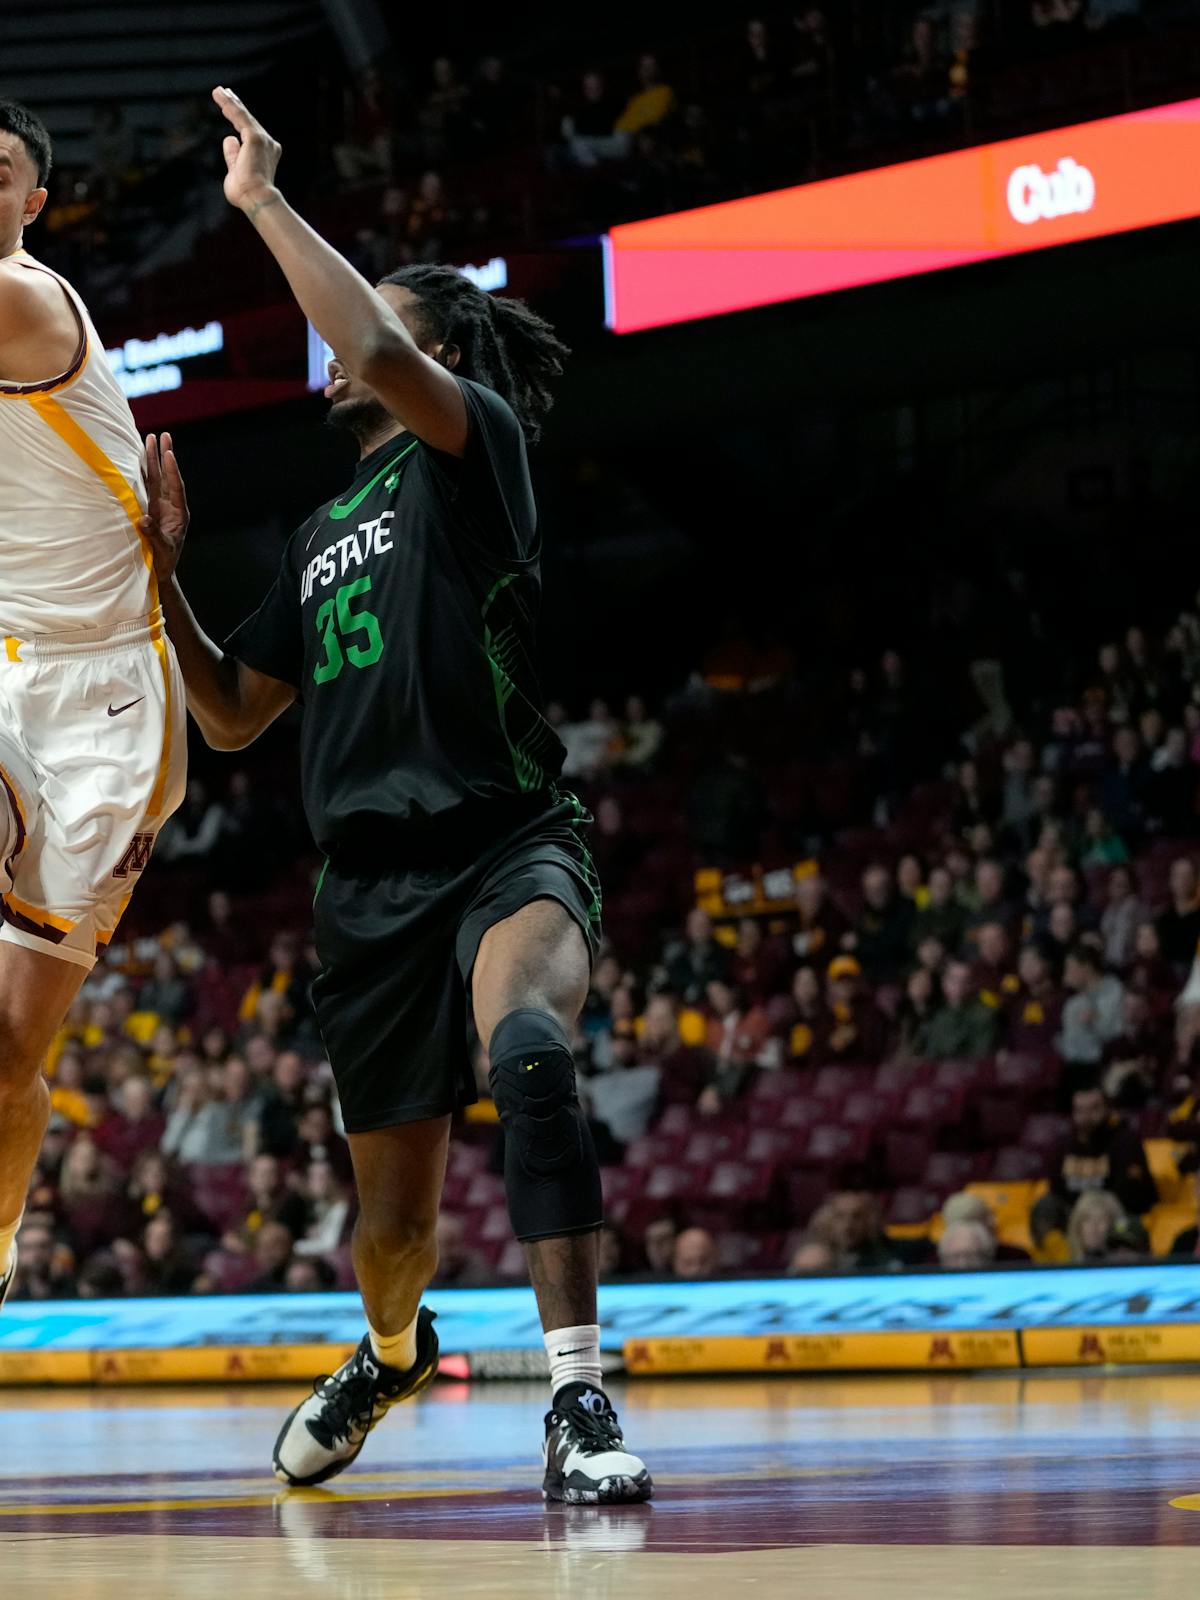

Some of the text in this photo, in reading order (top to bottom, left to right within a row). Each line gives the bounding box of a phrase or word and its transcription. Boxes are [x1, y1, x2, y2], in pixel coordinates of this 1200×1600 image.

[1007, 156, 1096, 224] Cub
[300, 510, 395, 606] UPSTATE
[313, 574, 385, 686] 35
[112, 831, 156, 879] M
